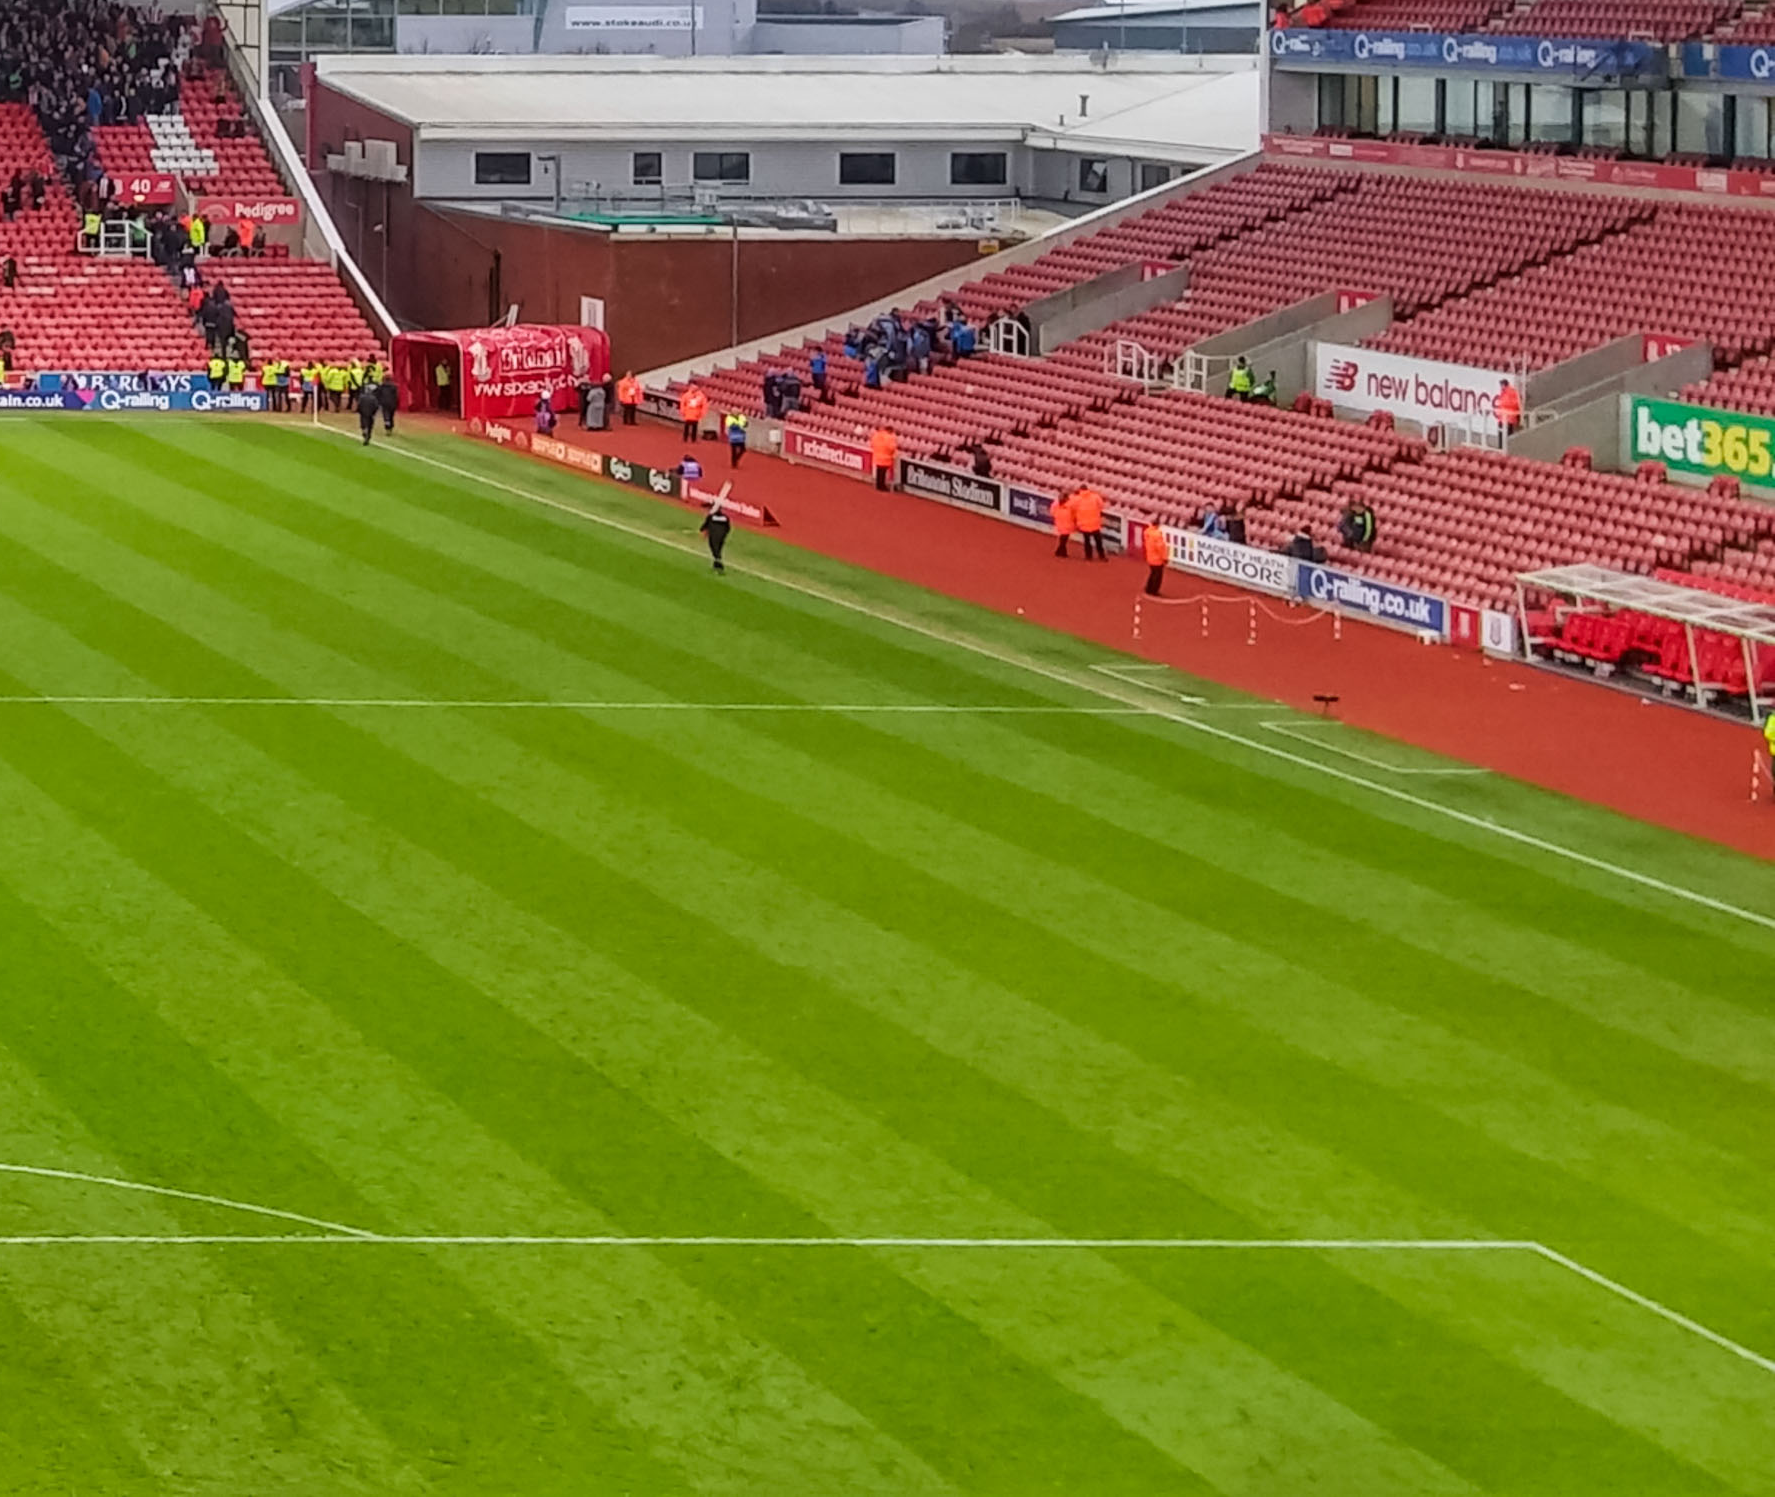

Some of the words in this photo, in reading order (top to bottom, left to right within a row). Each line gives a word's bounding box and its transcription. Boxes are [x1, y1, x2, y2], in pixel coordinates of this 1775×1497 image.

[130, 179, 151, 194] 40
[234, 202, 295, 221] Pedigree
[1367, 371, 1409, 402] new
[101, 390, 170, 410] Q-railing
[951, 476, 994, 506] Stadium
[1197, 540, 1246, 559] MADELEY
[1197, 550, 1284, 585] MOTORS
[1310, 569, 1432, 623] Q-railing.co.uk
